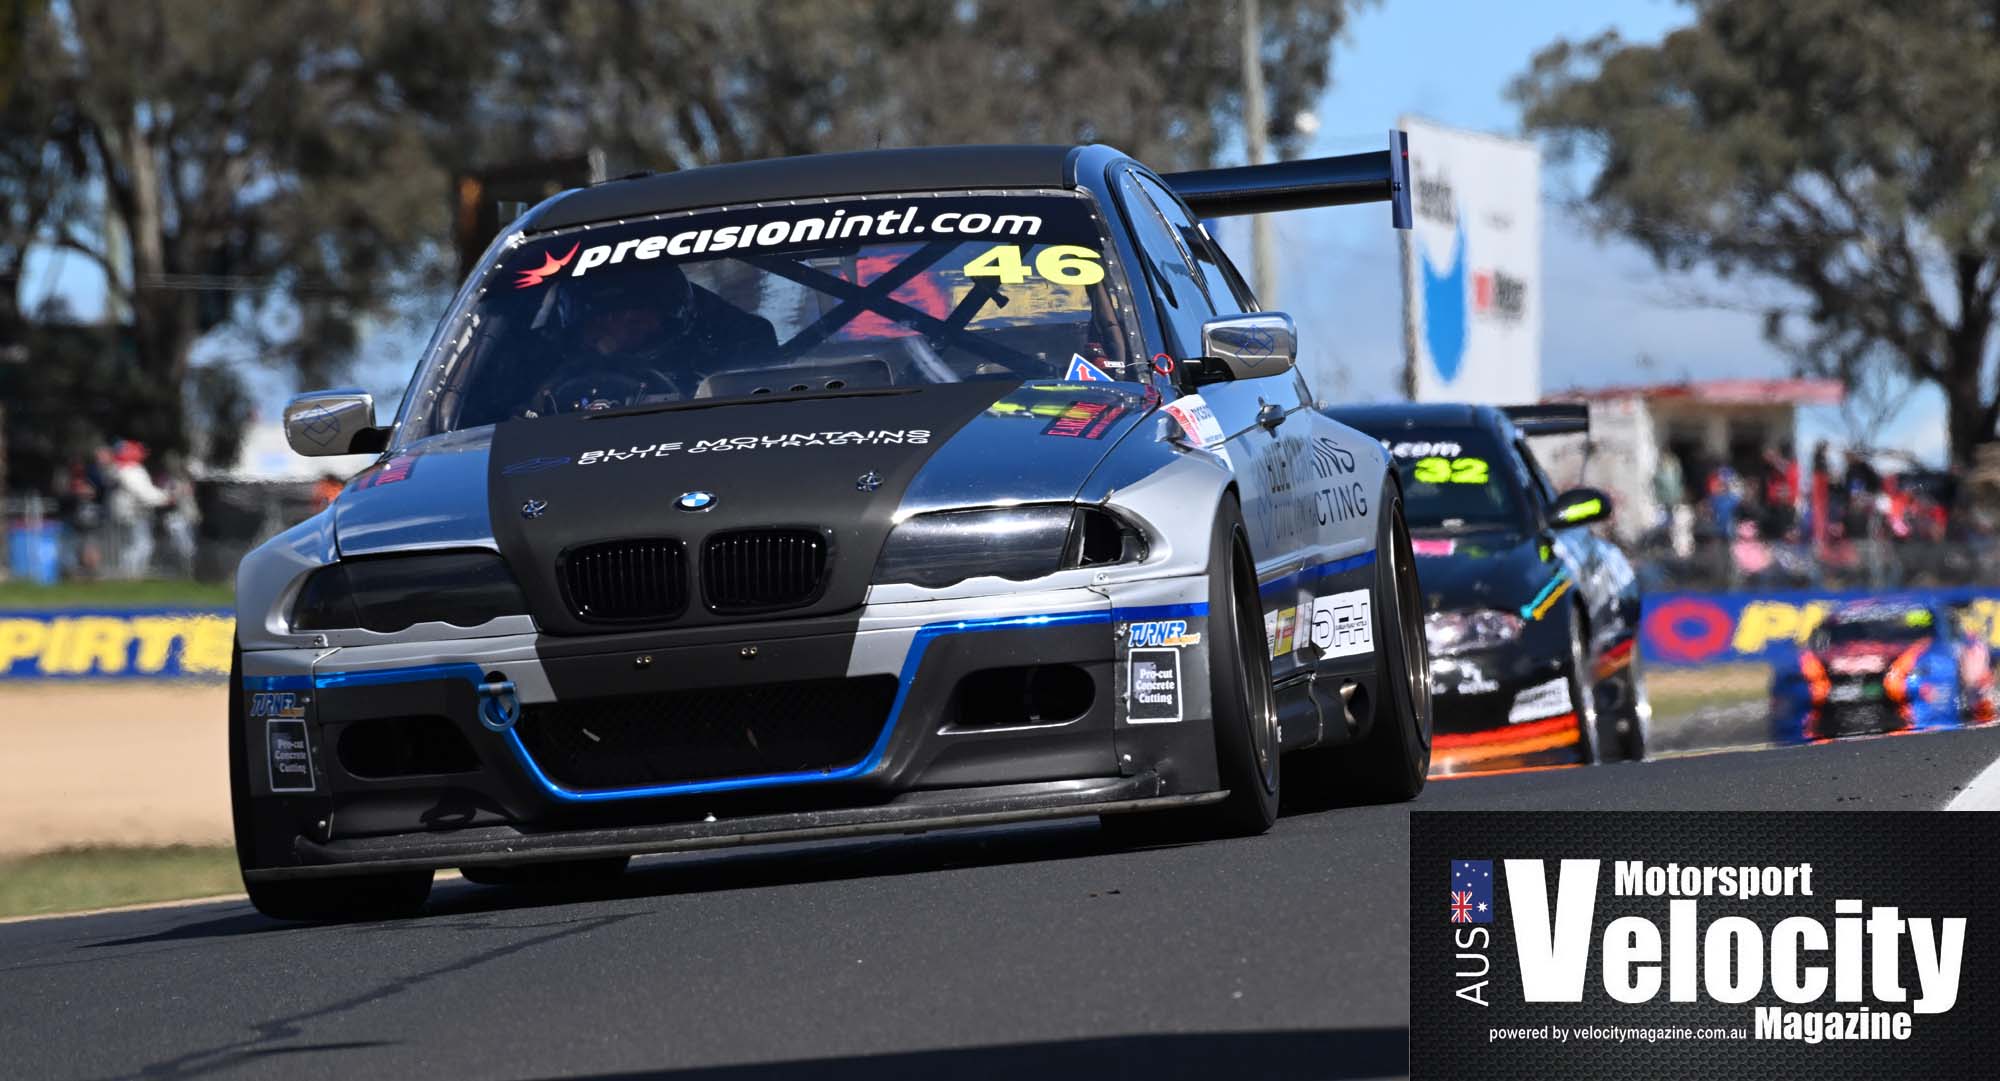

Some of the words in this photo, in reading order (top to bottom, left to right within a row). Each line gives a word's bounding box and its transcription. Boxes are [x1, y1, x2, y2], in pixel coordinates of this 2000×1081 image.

[572, 206, 1043, 277] precisionintl.com
[963, 244, 1105, 286] 46
[577, 450, 671, 465] CIVIL
[687, 436, 930, 454] CONTRACTING
[581, 441, 684, 460] BLUE
[695, 429, 932, 447] MOUNTAINS
[1414, 457, 1489, 484] 32
[0, 615, 236, 674] PIRTE
[1128, 620, 1188, 647] TURNER
[1136, 680, 1175, 690] Concrete
[1140, 668, 1173, 679] Pro-cut
[1139, 692, 1173, 704] Cutting
